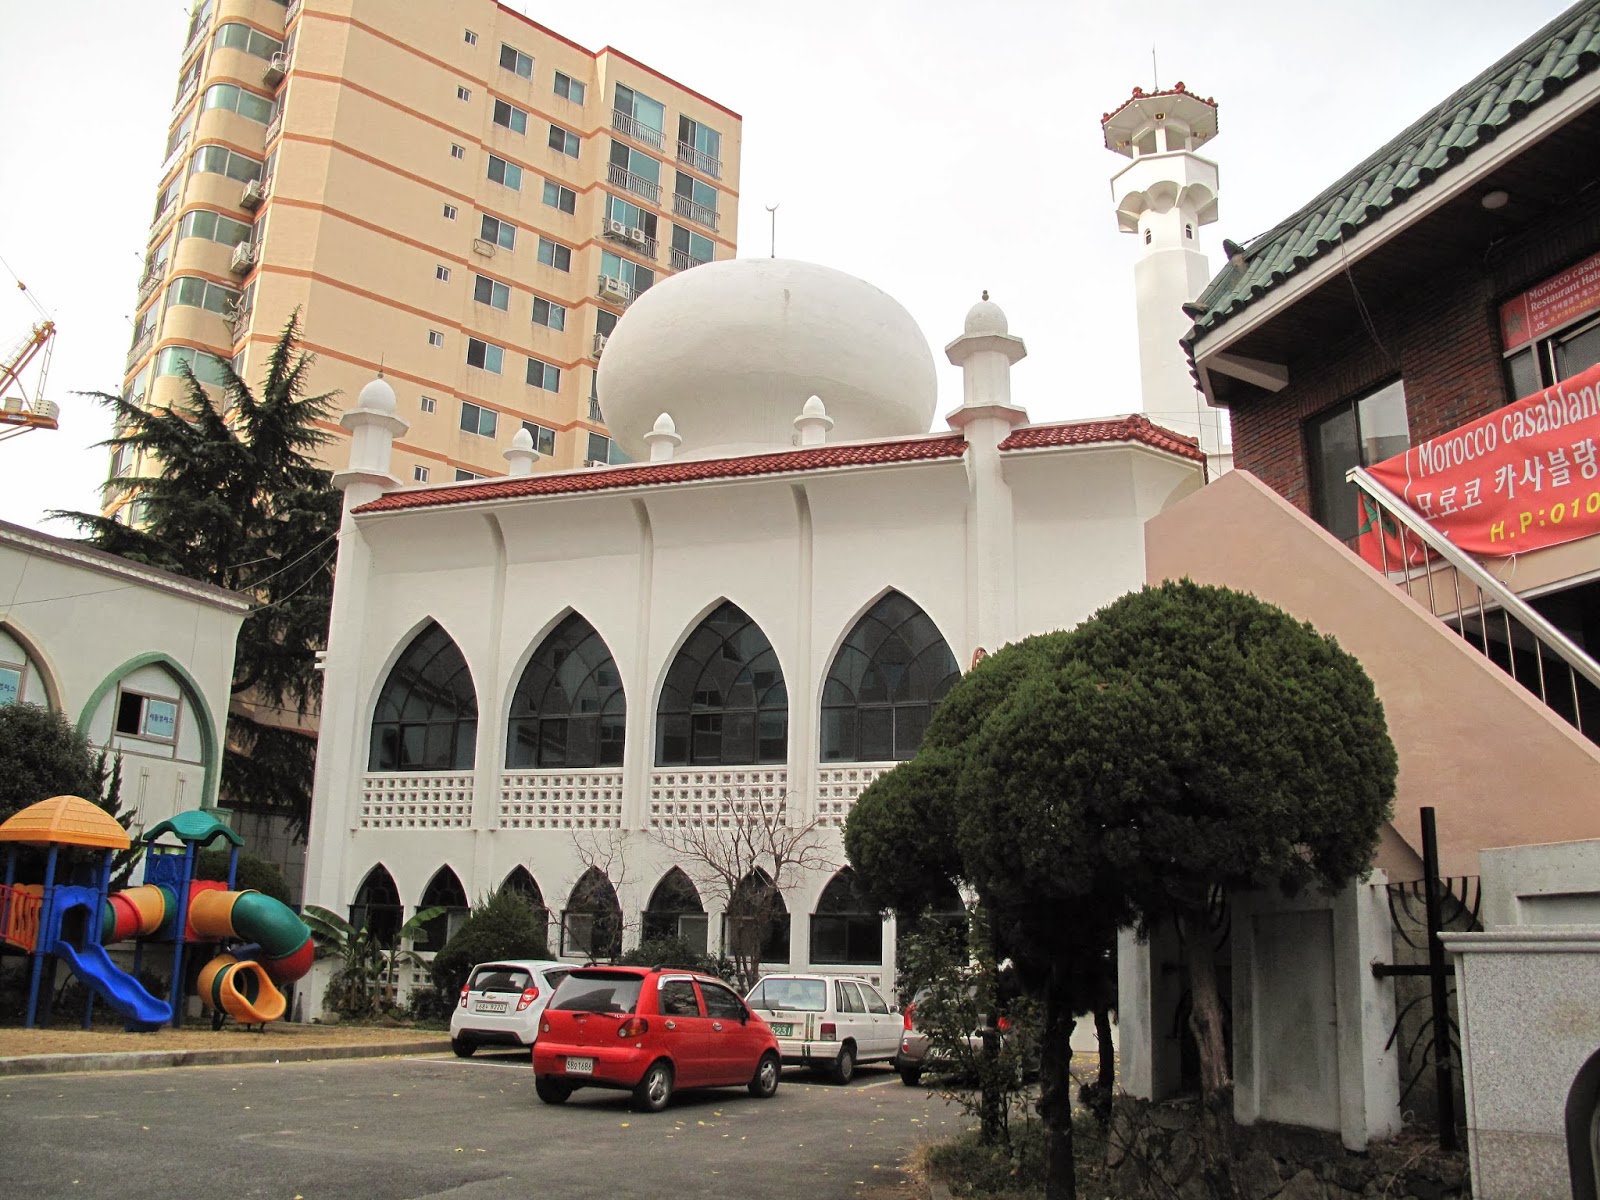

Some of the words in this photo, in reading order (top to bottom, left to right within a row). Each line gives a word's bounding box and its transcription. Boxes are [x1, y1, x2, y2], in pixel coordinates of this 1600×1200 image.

[1528, 275, 1571, 301] Morocco
[1530, 280, 1580, 312] Restaurant
[1418, 422, 1497, 478] Morocco
[1416, 477, 1482, 521] 모로코
